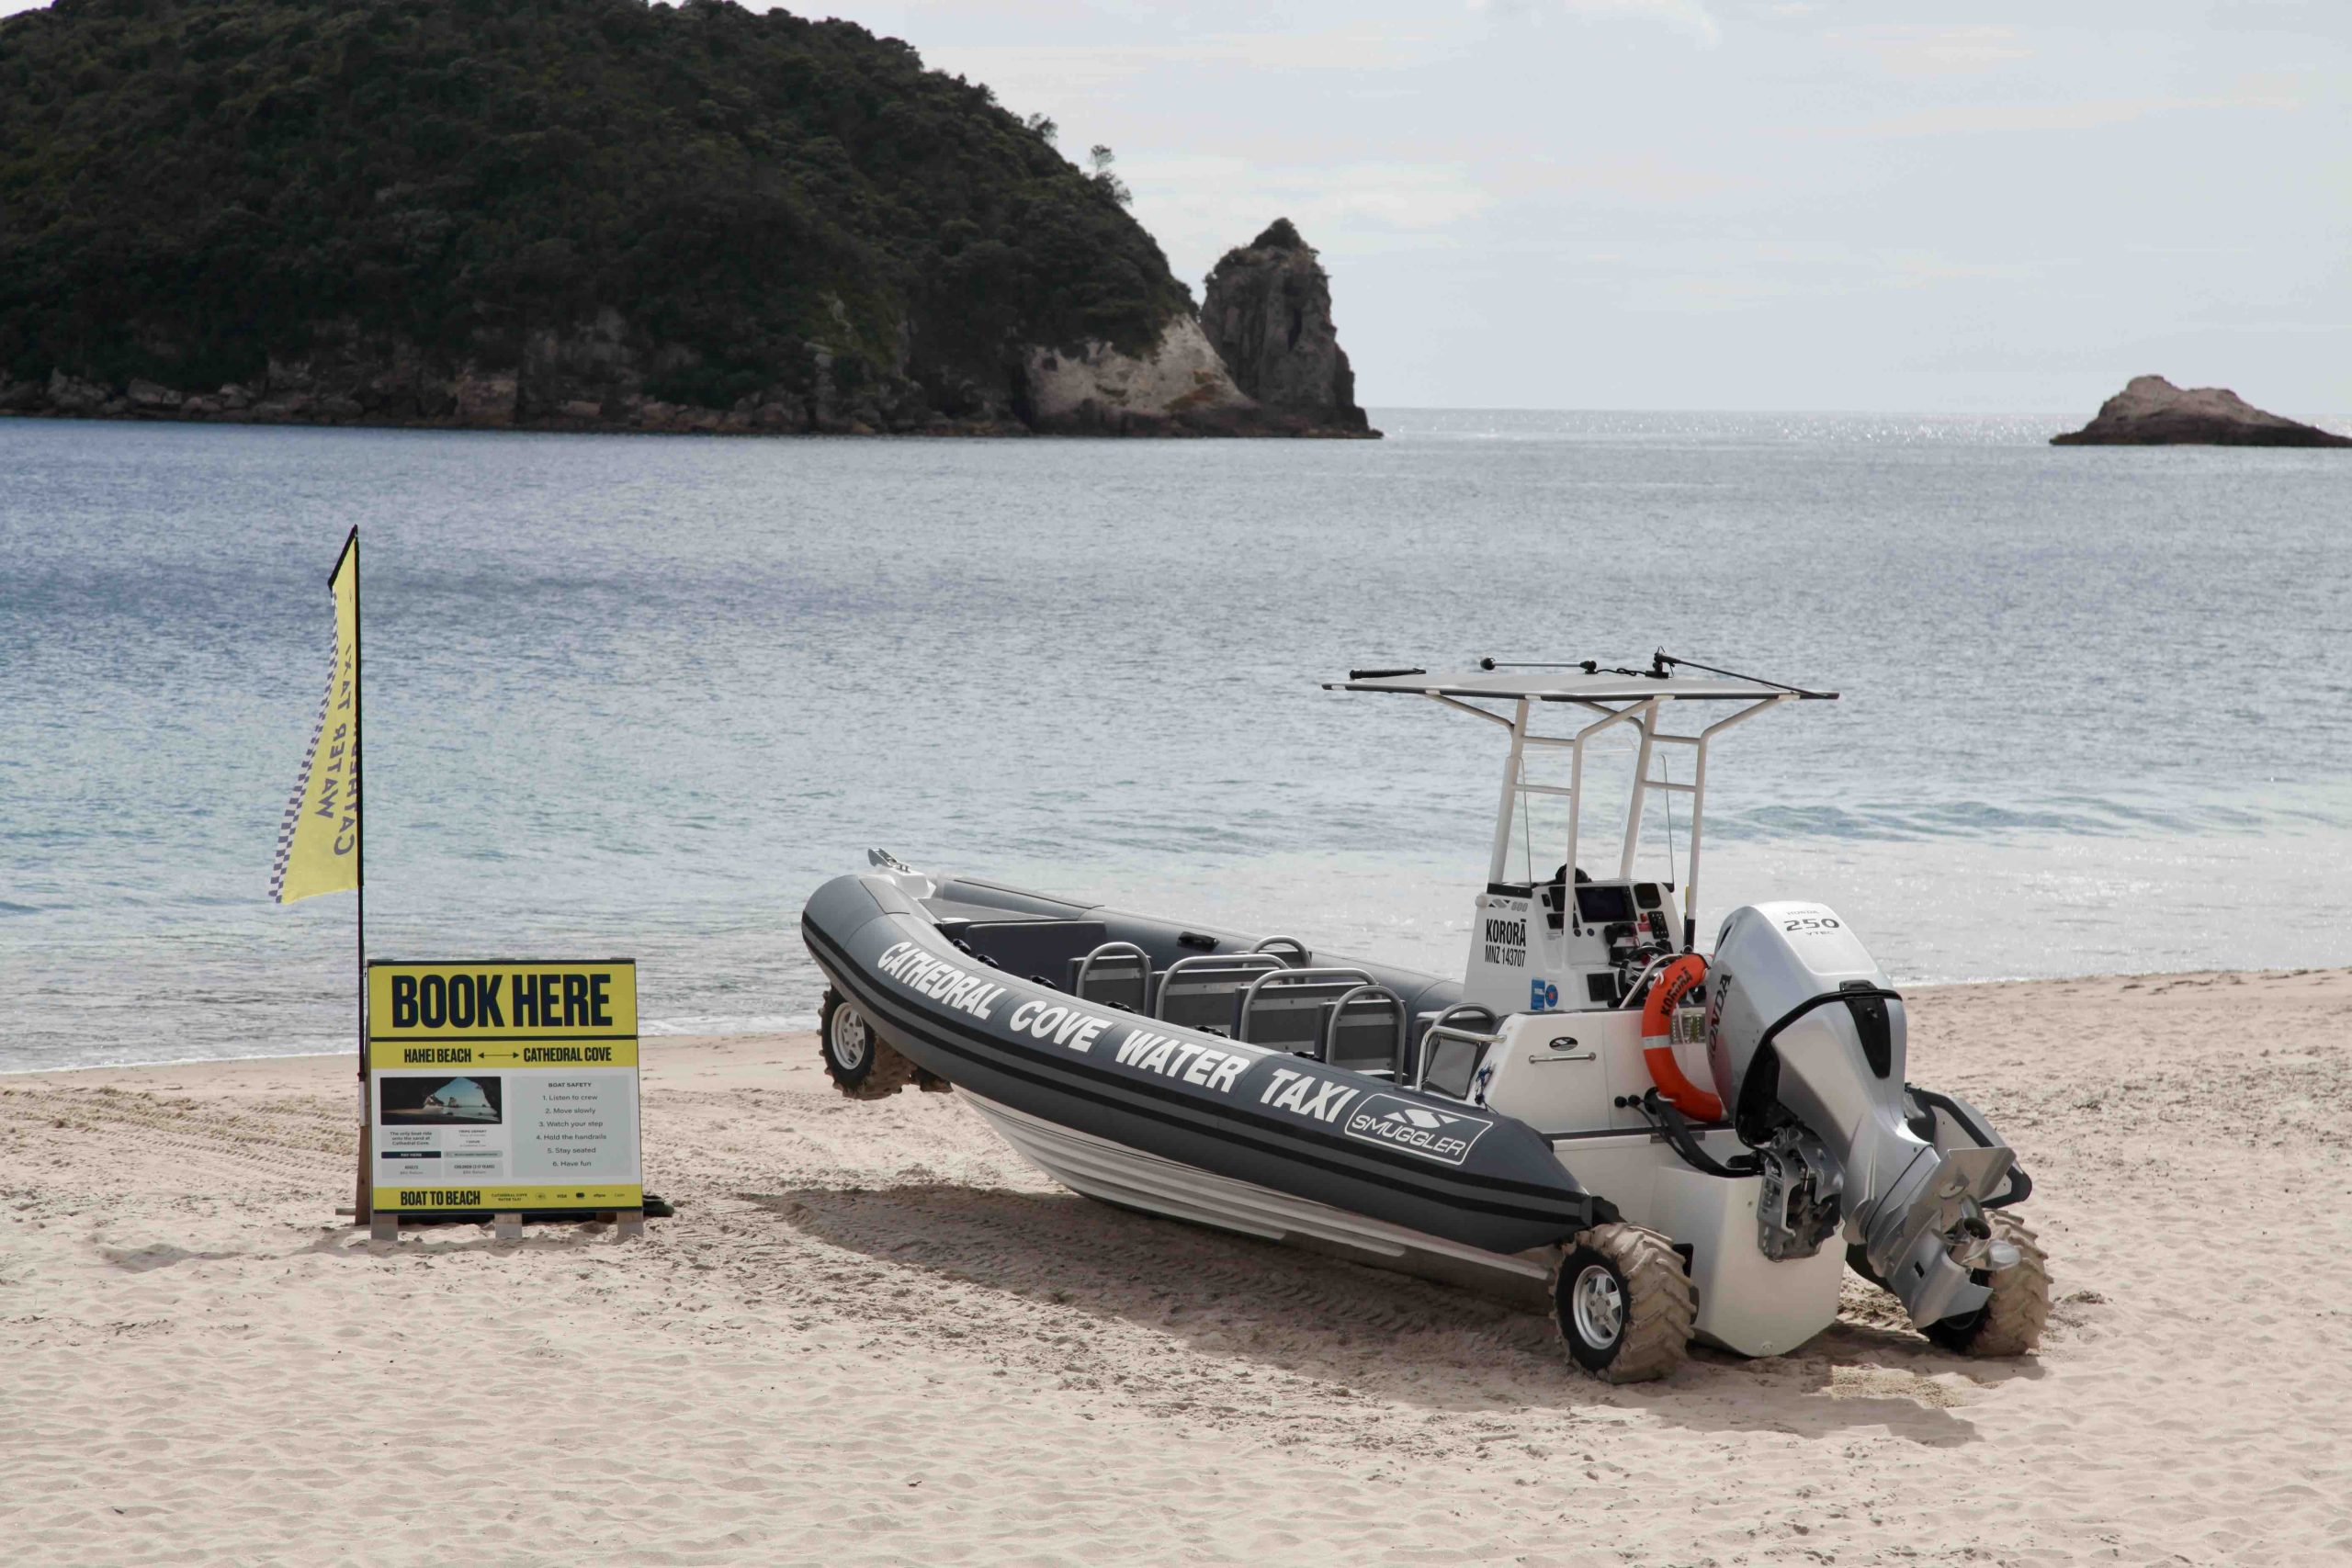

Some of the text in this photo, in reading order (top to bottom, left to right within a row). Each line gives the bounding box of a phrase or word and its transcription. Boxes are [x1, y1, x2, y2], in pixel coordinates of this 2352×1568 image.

[1486, 919, 1526, 947] KORORĀ
[1784, 919, 1839, 931] 250
[1485, 944, 1526, 968] MNZ 143707
[391, 974, 613, 1028] BOOK HERE
[1708, 974, 1733, 1061] ONDA
[877, 942, 1360, 1122] CATHEDRAL COVE WATER TAXI
[403, 1048, 471, 1063] HAHEI BEACH
[524, 1047, 612, 1062] CATHEDRAL COVE
[1351, 1114, 1466, 1156] SMUGGLER
[400, 1190, 481, 1205] BOAT TO BEACH
